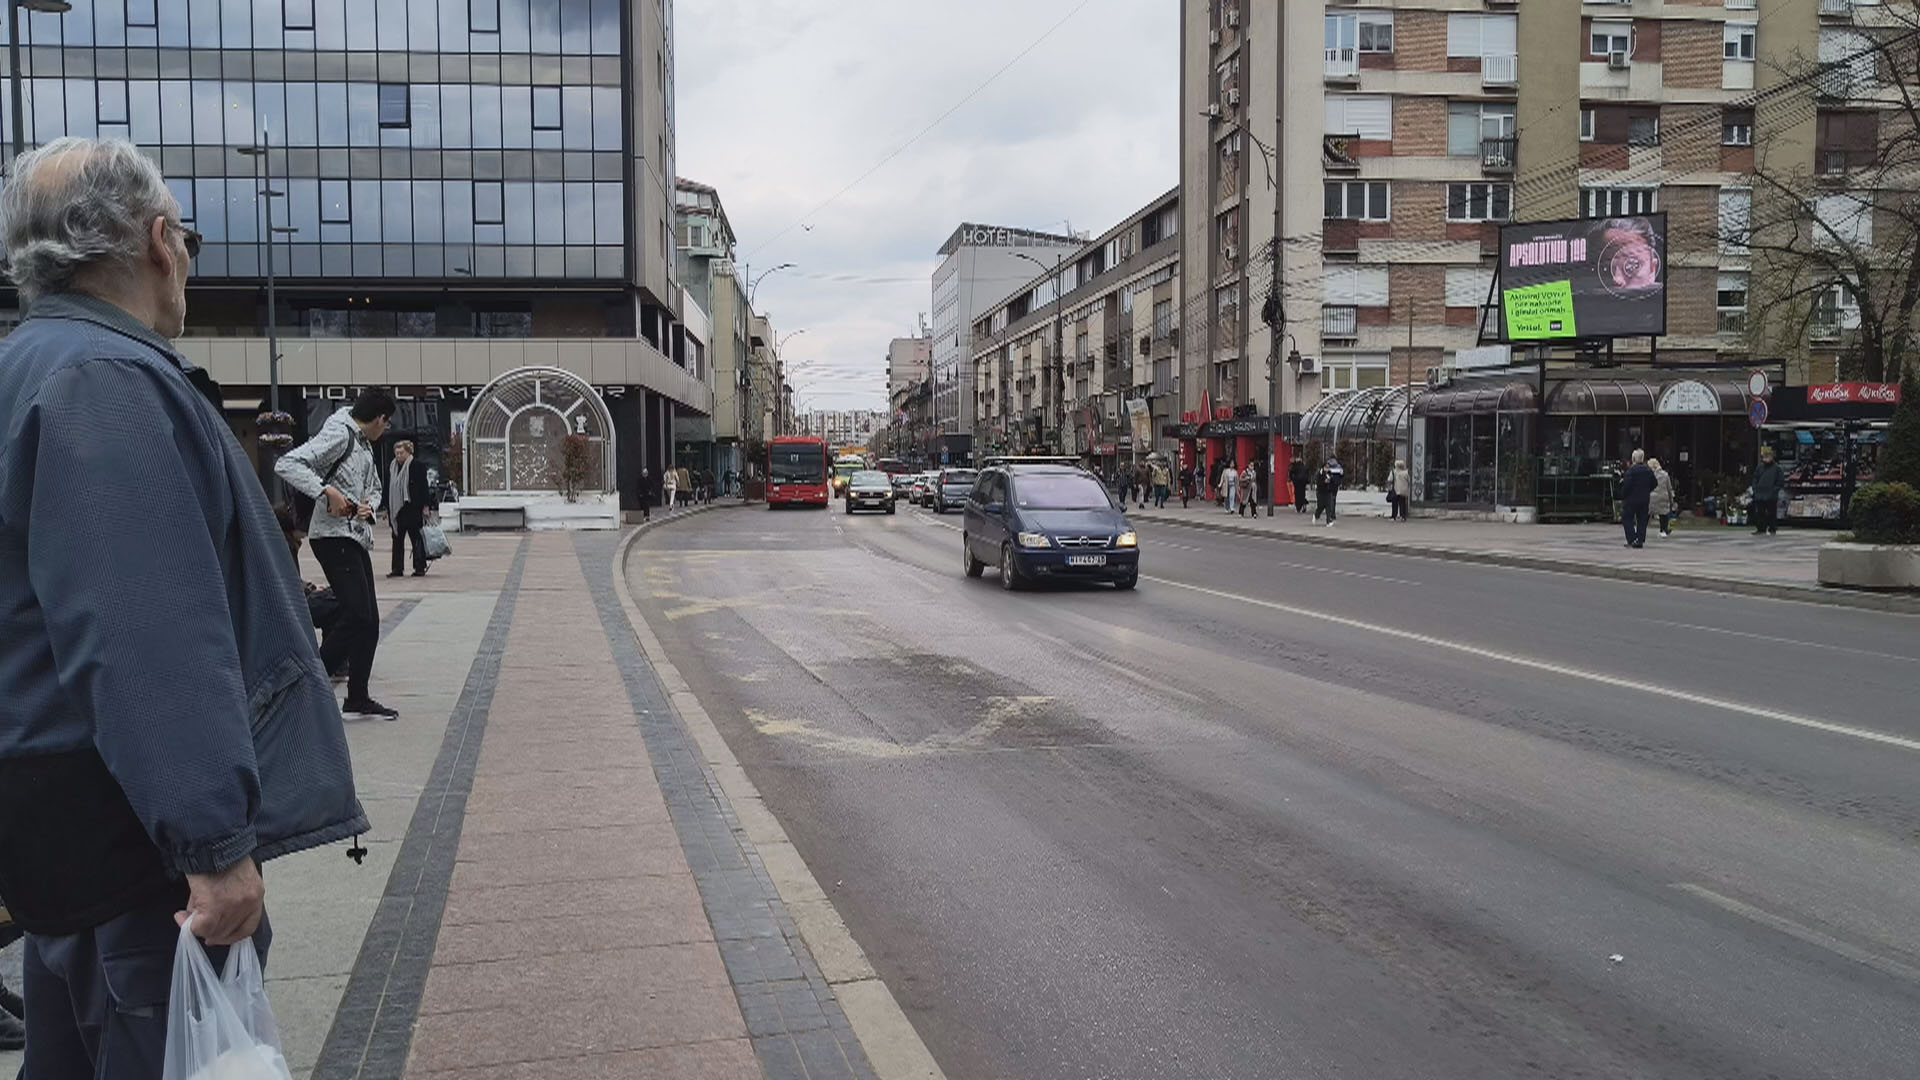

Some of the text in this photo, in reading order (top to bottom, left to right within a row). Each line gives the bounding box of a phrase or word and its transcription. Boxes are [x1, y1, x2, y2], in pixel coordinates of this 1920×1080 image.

[963, 229, 1013, 246] HOTEL
[1510, 238, 1586, 267] APSOLUTNO 100
